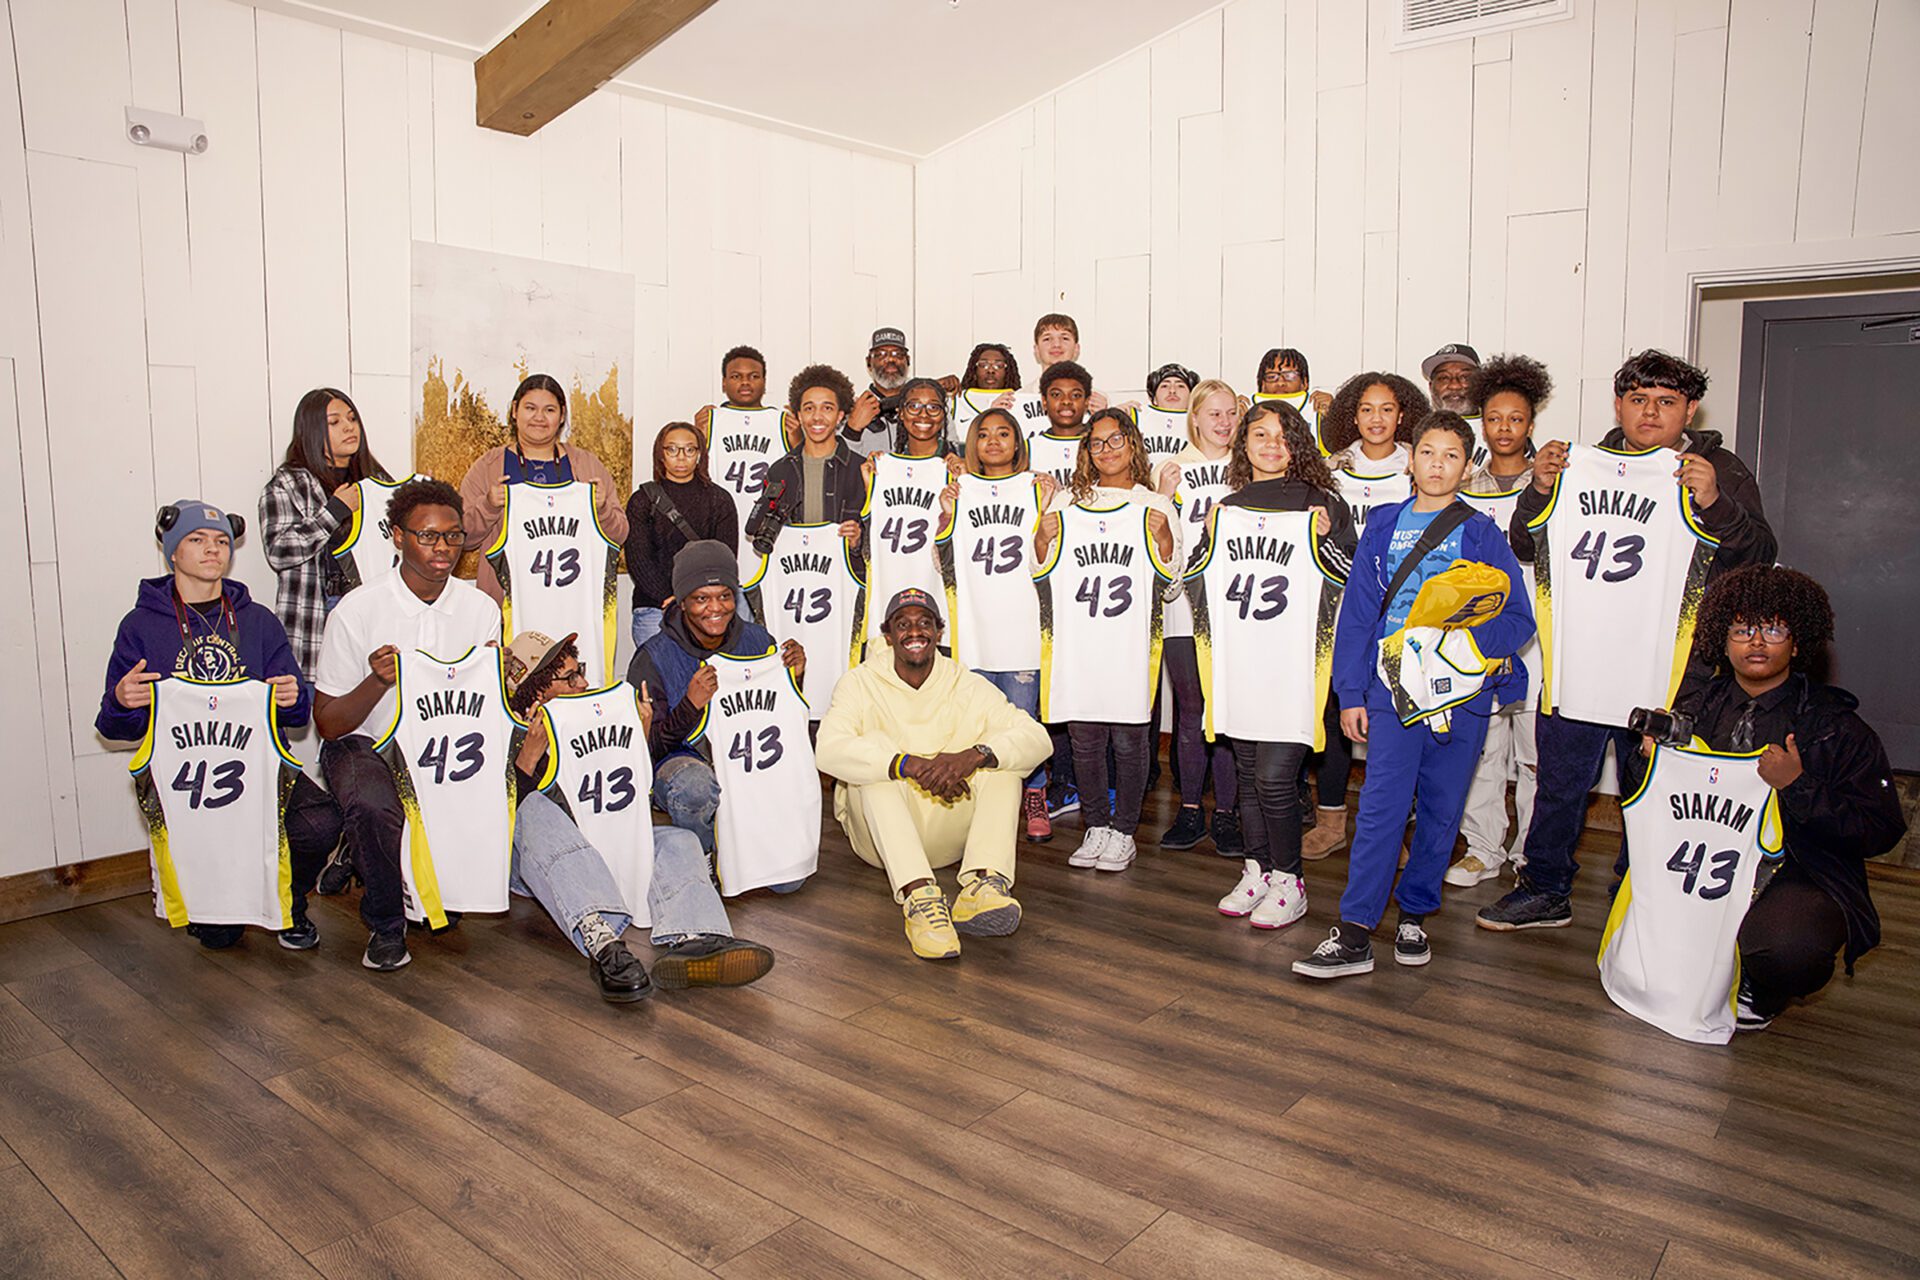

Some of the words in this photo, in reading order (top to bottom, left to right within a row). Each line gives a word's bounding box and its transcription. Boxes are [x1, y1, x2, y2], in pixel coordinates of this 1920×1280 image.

[722, 434, 771, 454] SIAKAM
[724, 460, 769, 493] 43
[1184, 464, 1233, 490] SIAKA
[883, 486, 936, 511] SIAKAM
[968, 504, 1025, 529] SIAKAM
[1578, 489, 1657, 525] SIAKAM
[523, 516, 580, 540] SIAKAM
[880, 517, 929, 554] 43
[530, 548, 581, 588] 43
[780, 552, 833, 575] SIAKAM
[971, 535, 1023, 576] 43
[1073, 542, 1134, 568] SIAKAM
[1226, 536, 1295, 567] SIAKAM
[1570, 530, 1646, 583] 43
[783, 587, 832, 624] 43
[1075, 575, 1133, 618] 43
[1225, 573, 1289, 621] 43
[416, 690, 486, 722] SIAKAM
[719, 689, 777, 718] SIAKAM
[171, 720, 253, 751] SIAKAM
[570, 724, 634, 759] SIAKAM
[728, 725, 784, 773] 43
[417, 732, 485, 785] 43
[171, 759, 246, 810] 43
[577, 766, 636, 814] 43
[1669, 792, 1755, 834] SIAKAM
[1666, 840, 1741, 901] 43
